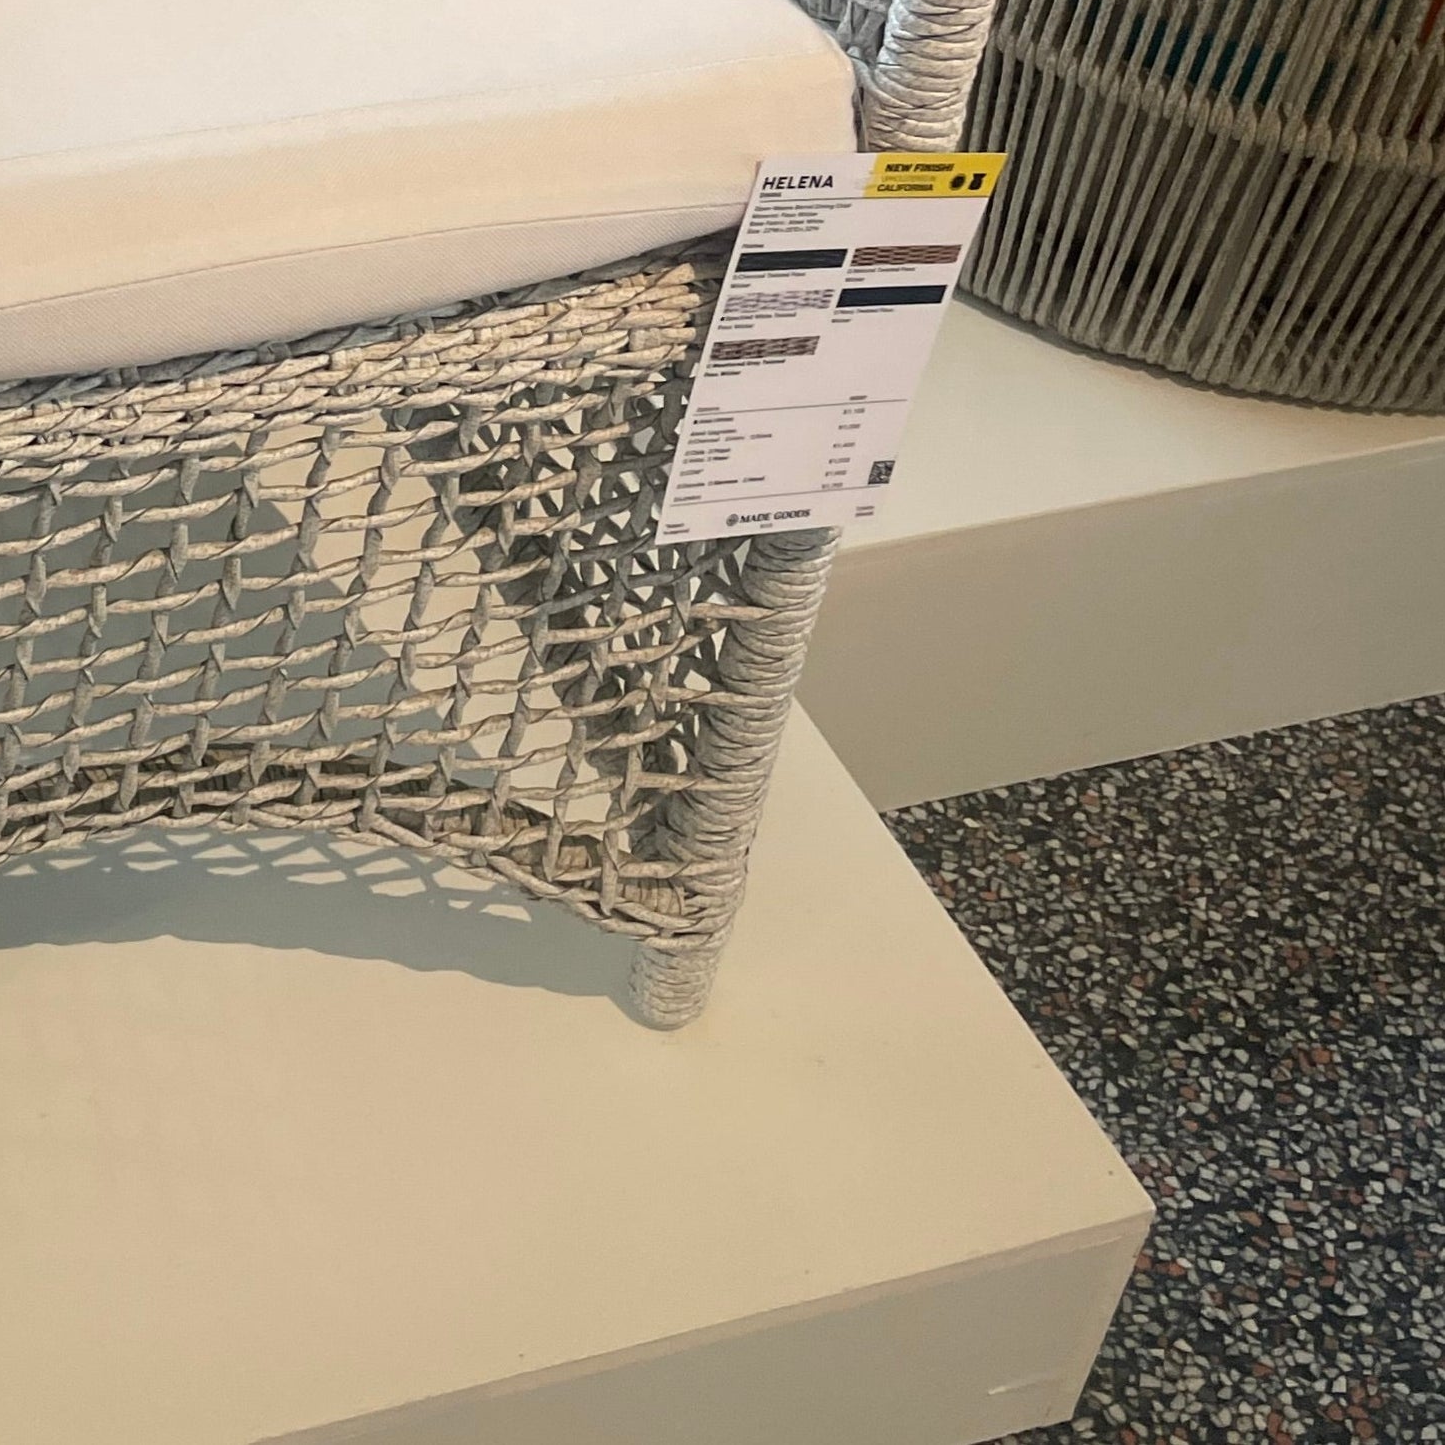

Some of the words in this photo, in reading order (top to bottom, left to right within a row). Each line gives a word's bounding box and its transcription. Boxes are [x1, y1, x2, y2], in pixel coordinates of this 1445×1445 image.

[884, 163, 913, 172] NEW
[761, 175, 834, 191] HELENA
[876, 183, 934, 192] CALIFORNIA
[738, 512, 772, 524] MADE
[773, 509, 812, 521] GOODS
